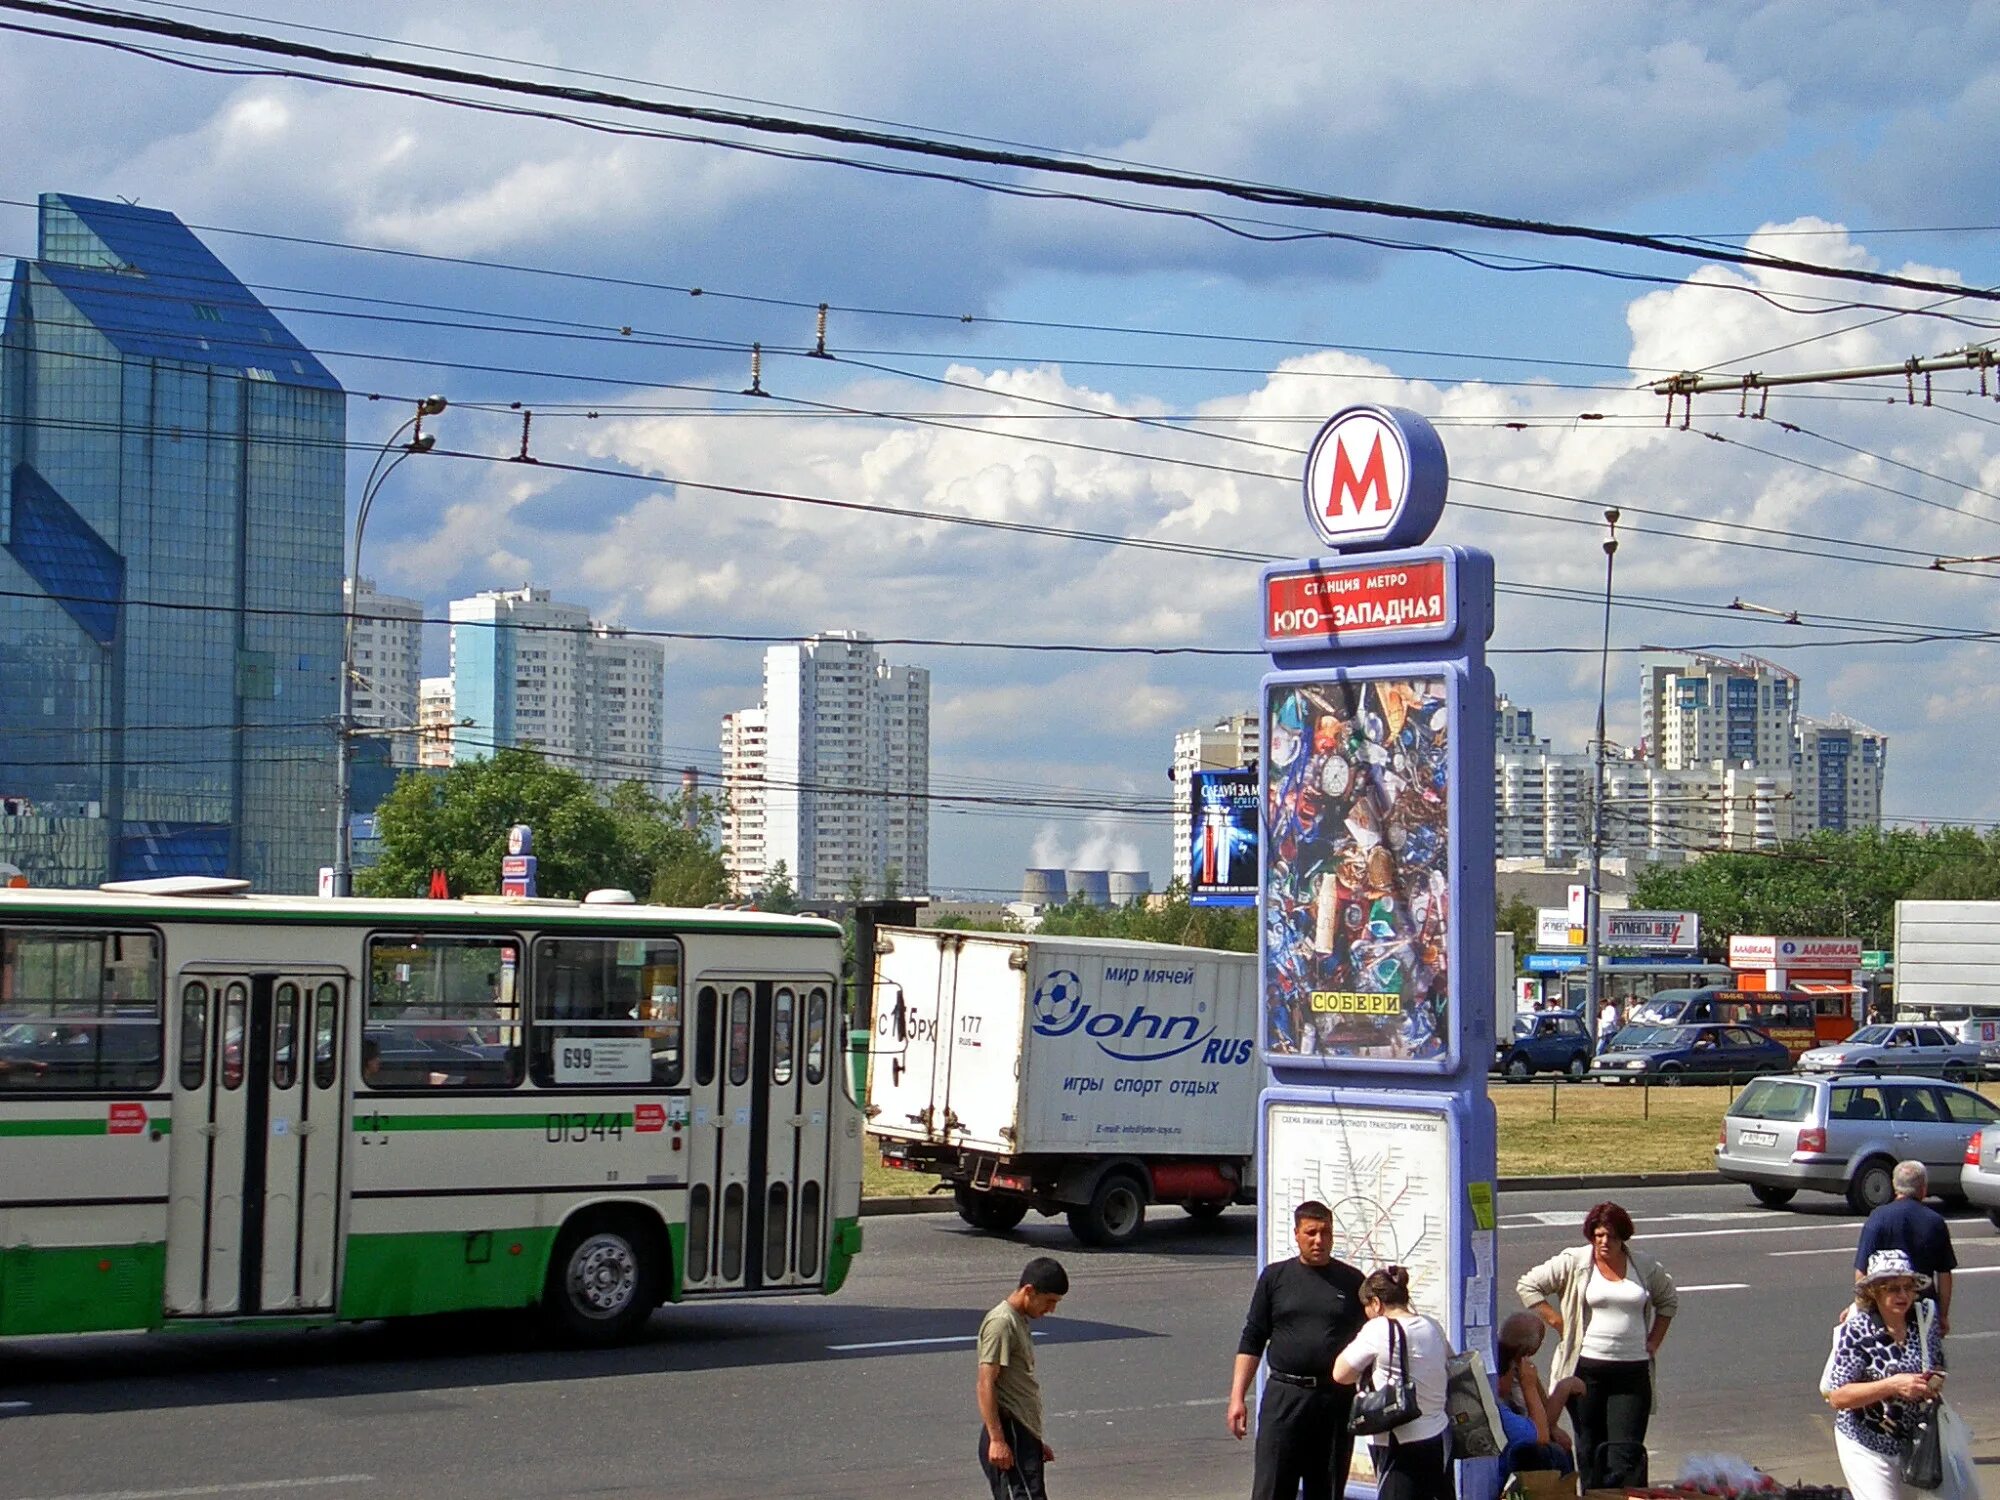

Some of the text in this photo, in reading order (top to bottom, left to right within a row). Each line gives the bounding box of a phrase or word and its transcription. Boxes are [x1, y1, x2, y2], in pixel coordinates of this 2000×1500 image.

[1326, 428, 1392, 517] М
[1304, 572, 1408, 596] СТАНЦИЯ МЕТРО
[1273, 595, 1441, 632] ЮГО-ЗАПАДНАЯ
[1106, 967, 1194, 986] мир мячей
[1313, 994, 1400, 1012] СОБЕРИ
[961, 1015, 982, 1033] 177
[1032, 1004, 1200, 1040] John
[563, 1048, 592, 1069] 699
[1201, 1038, 1254, 1065] RUS
[1063, 1076, 1219, 1097] игры спорт отдых
[547, 1113, 622, 1143] 01344
[1303, 1116, 1324, 1125] ЛИНИЙ
[1326, 1117, 1367, 1128] СКОРОСТНОГО
[1369, 1120, 1407, 1130] ТРАНСПОРТА
[1410, 1123, 1438, 1132] МОСКВЫ
